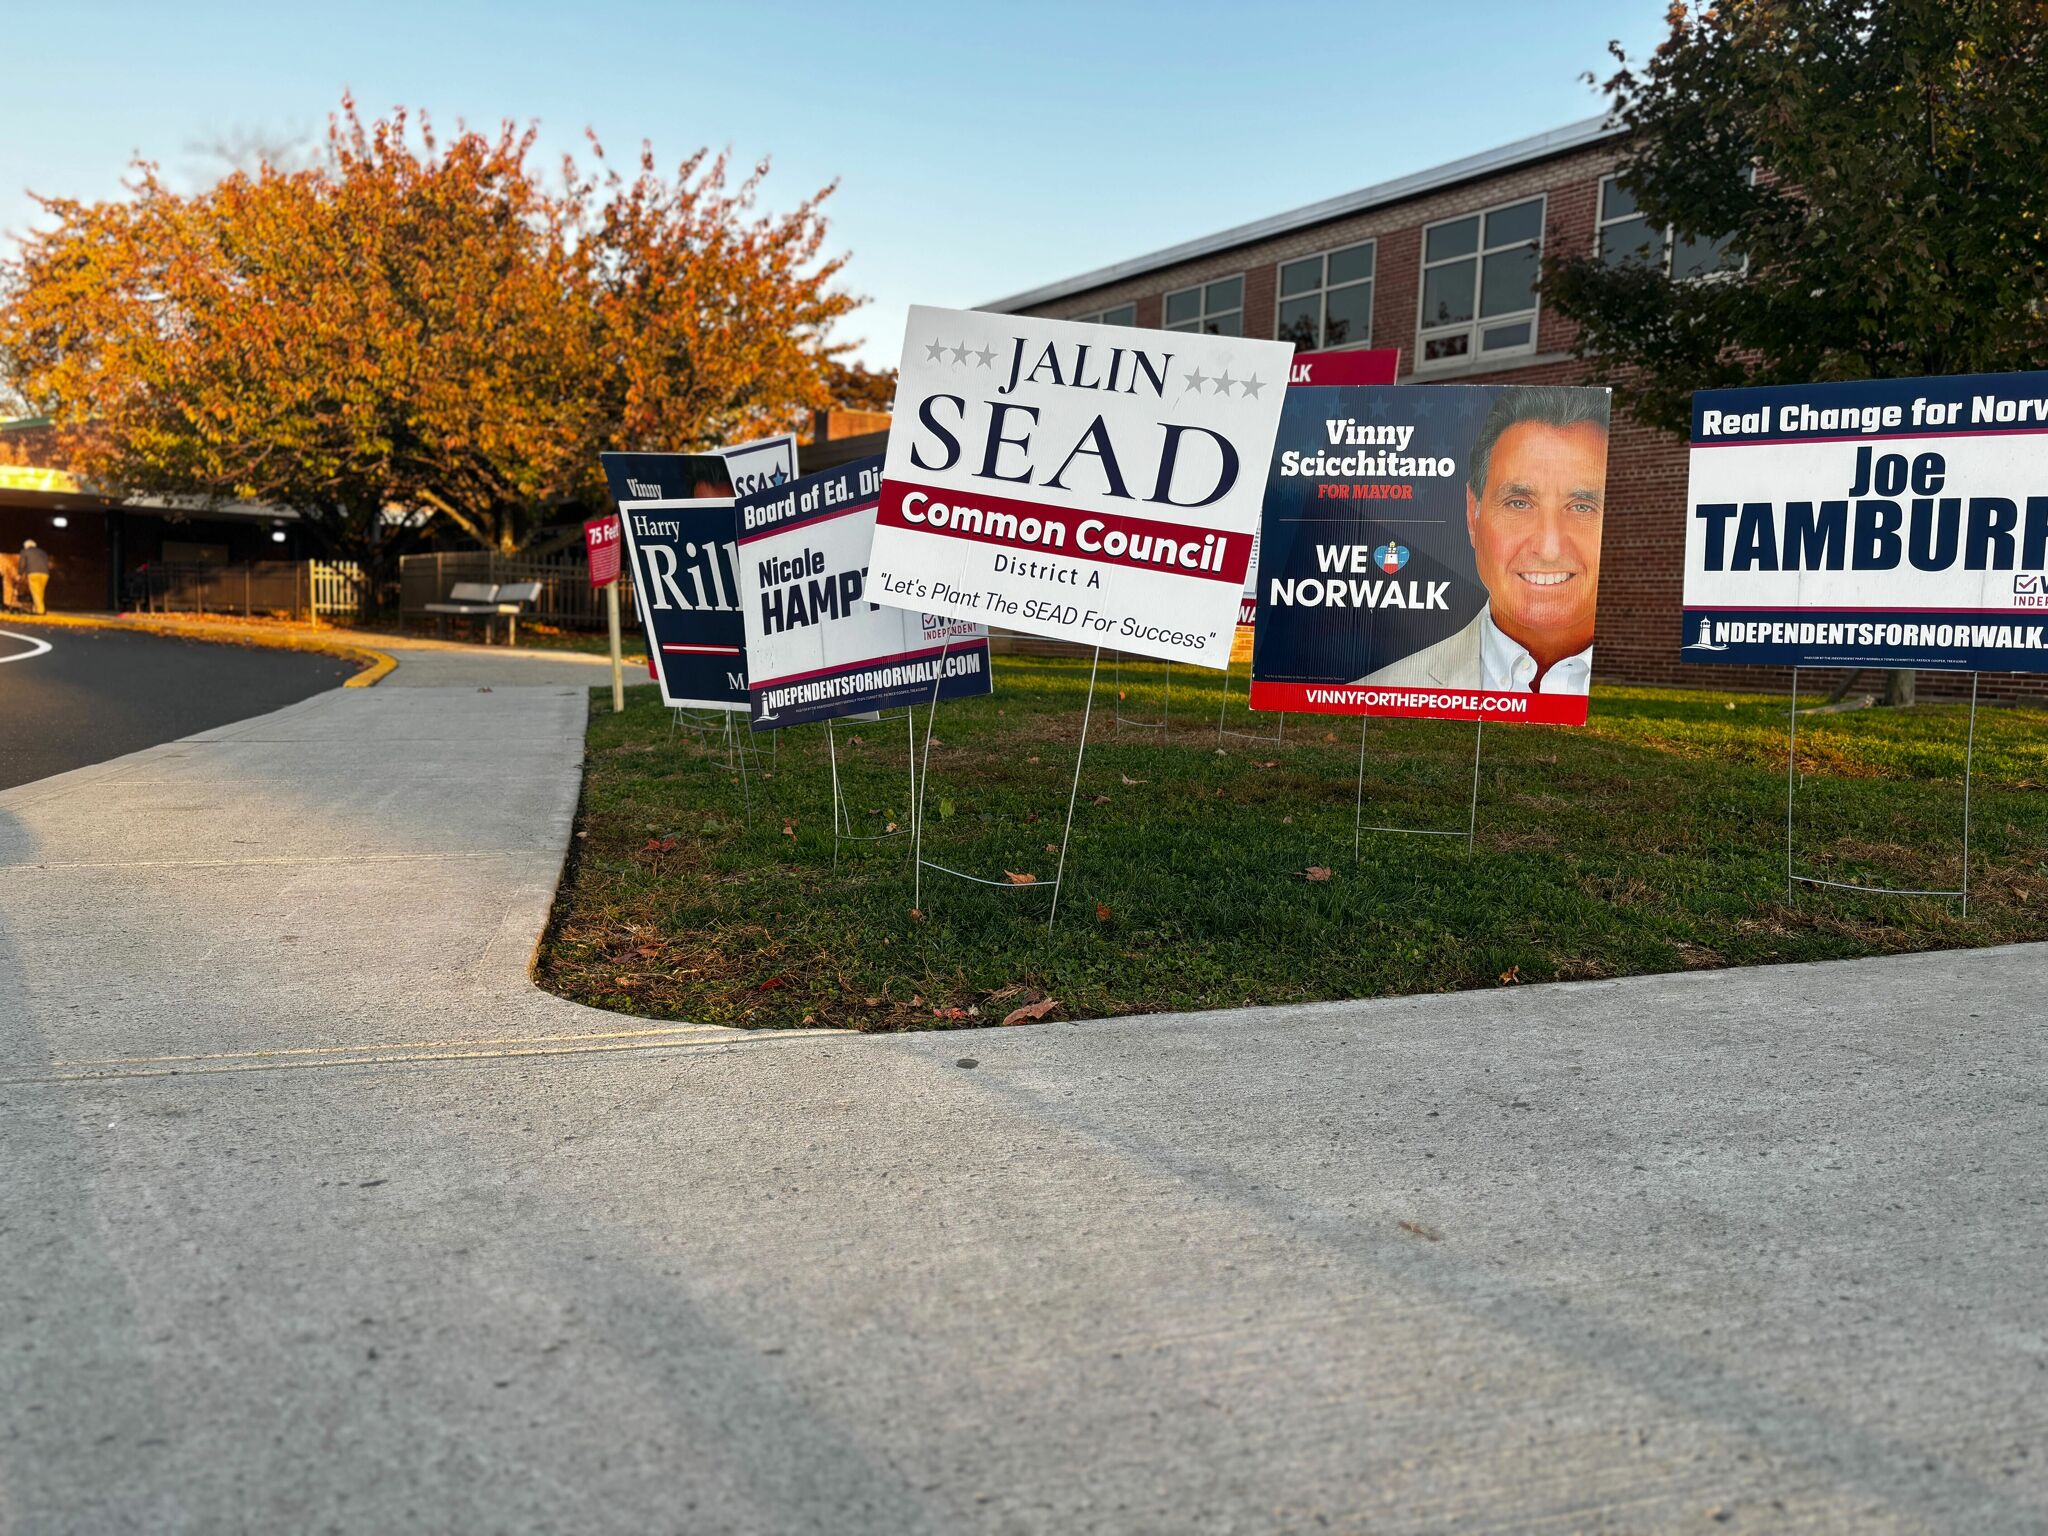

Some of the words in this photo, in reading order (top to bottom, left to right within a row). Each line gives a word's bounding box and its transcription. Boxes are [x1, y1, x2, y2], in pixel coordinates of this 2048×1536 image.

[998, 336, 1175, 398] JALIN
[1288, 364, 1313, 382] LK
[1702, 406, 1770, 436] Real
[1779, 404, 1902, 433] Change
[1912, 398, 1963, 426] for
[910, 393, 1240, 507] SEAD
[1326, 418, 1415, 452] Vinny
[1280, 451, 1456, 478] Scicchitano
[1849, 446, 1946, 498] Joe
[626, 478, 662, 499] Vinny
[744, 491, 796, 530] Board
[800, 483, 820, 513] of
[824, 475, 854, 506] Ed.
[1318, 484, 1350, 500] FOR
[1352, 484, 1413, 500] MAYOR
[589, 526, 602, 545] 75
[633, 515, 680, 543] Harry
[901, 491, 1066, 548] Common
[1075, 518, 1228, 573] Council
[758, 548, 825, 589] Nicole
[994, 554, 1078, 585] District
[1088, 569, 1100, 589] A
[1316, 544, 1368, 573] WE
[1270, 578, 1451, 610] NORWALK
[880, 572, 927, 598] "Let's
[931, 582, 980, 608] Plant
[986, 592, 1018, 617] The
[1022, 600, 1078, 626] SEAD
[1082, 611, 1116, 633] For
[1120, 616, 1216, 650] Success"
[923, 622, 977, 640] INDEPENDENT
[727, 672, 750, 691] M
[1306, 689, 1528, 714] VINNYFORTHEPEOPLE.COM
